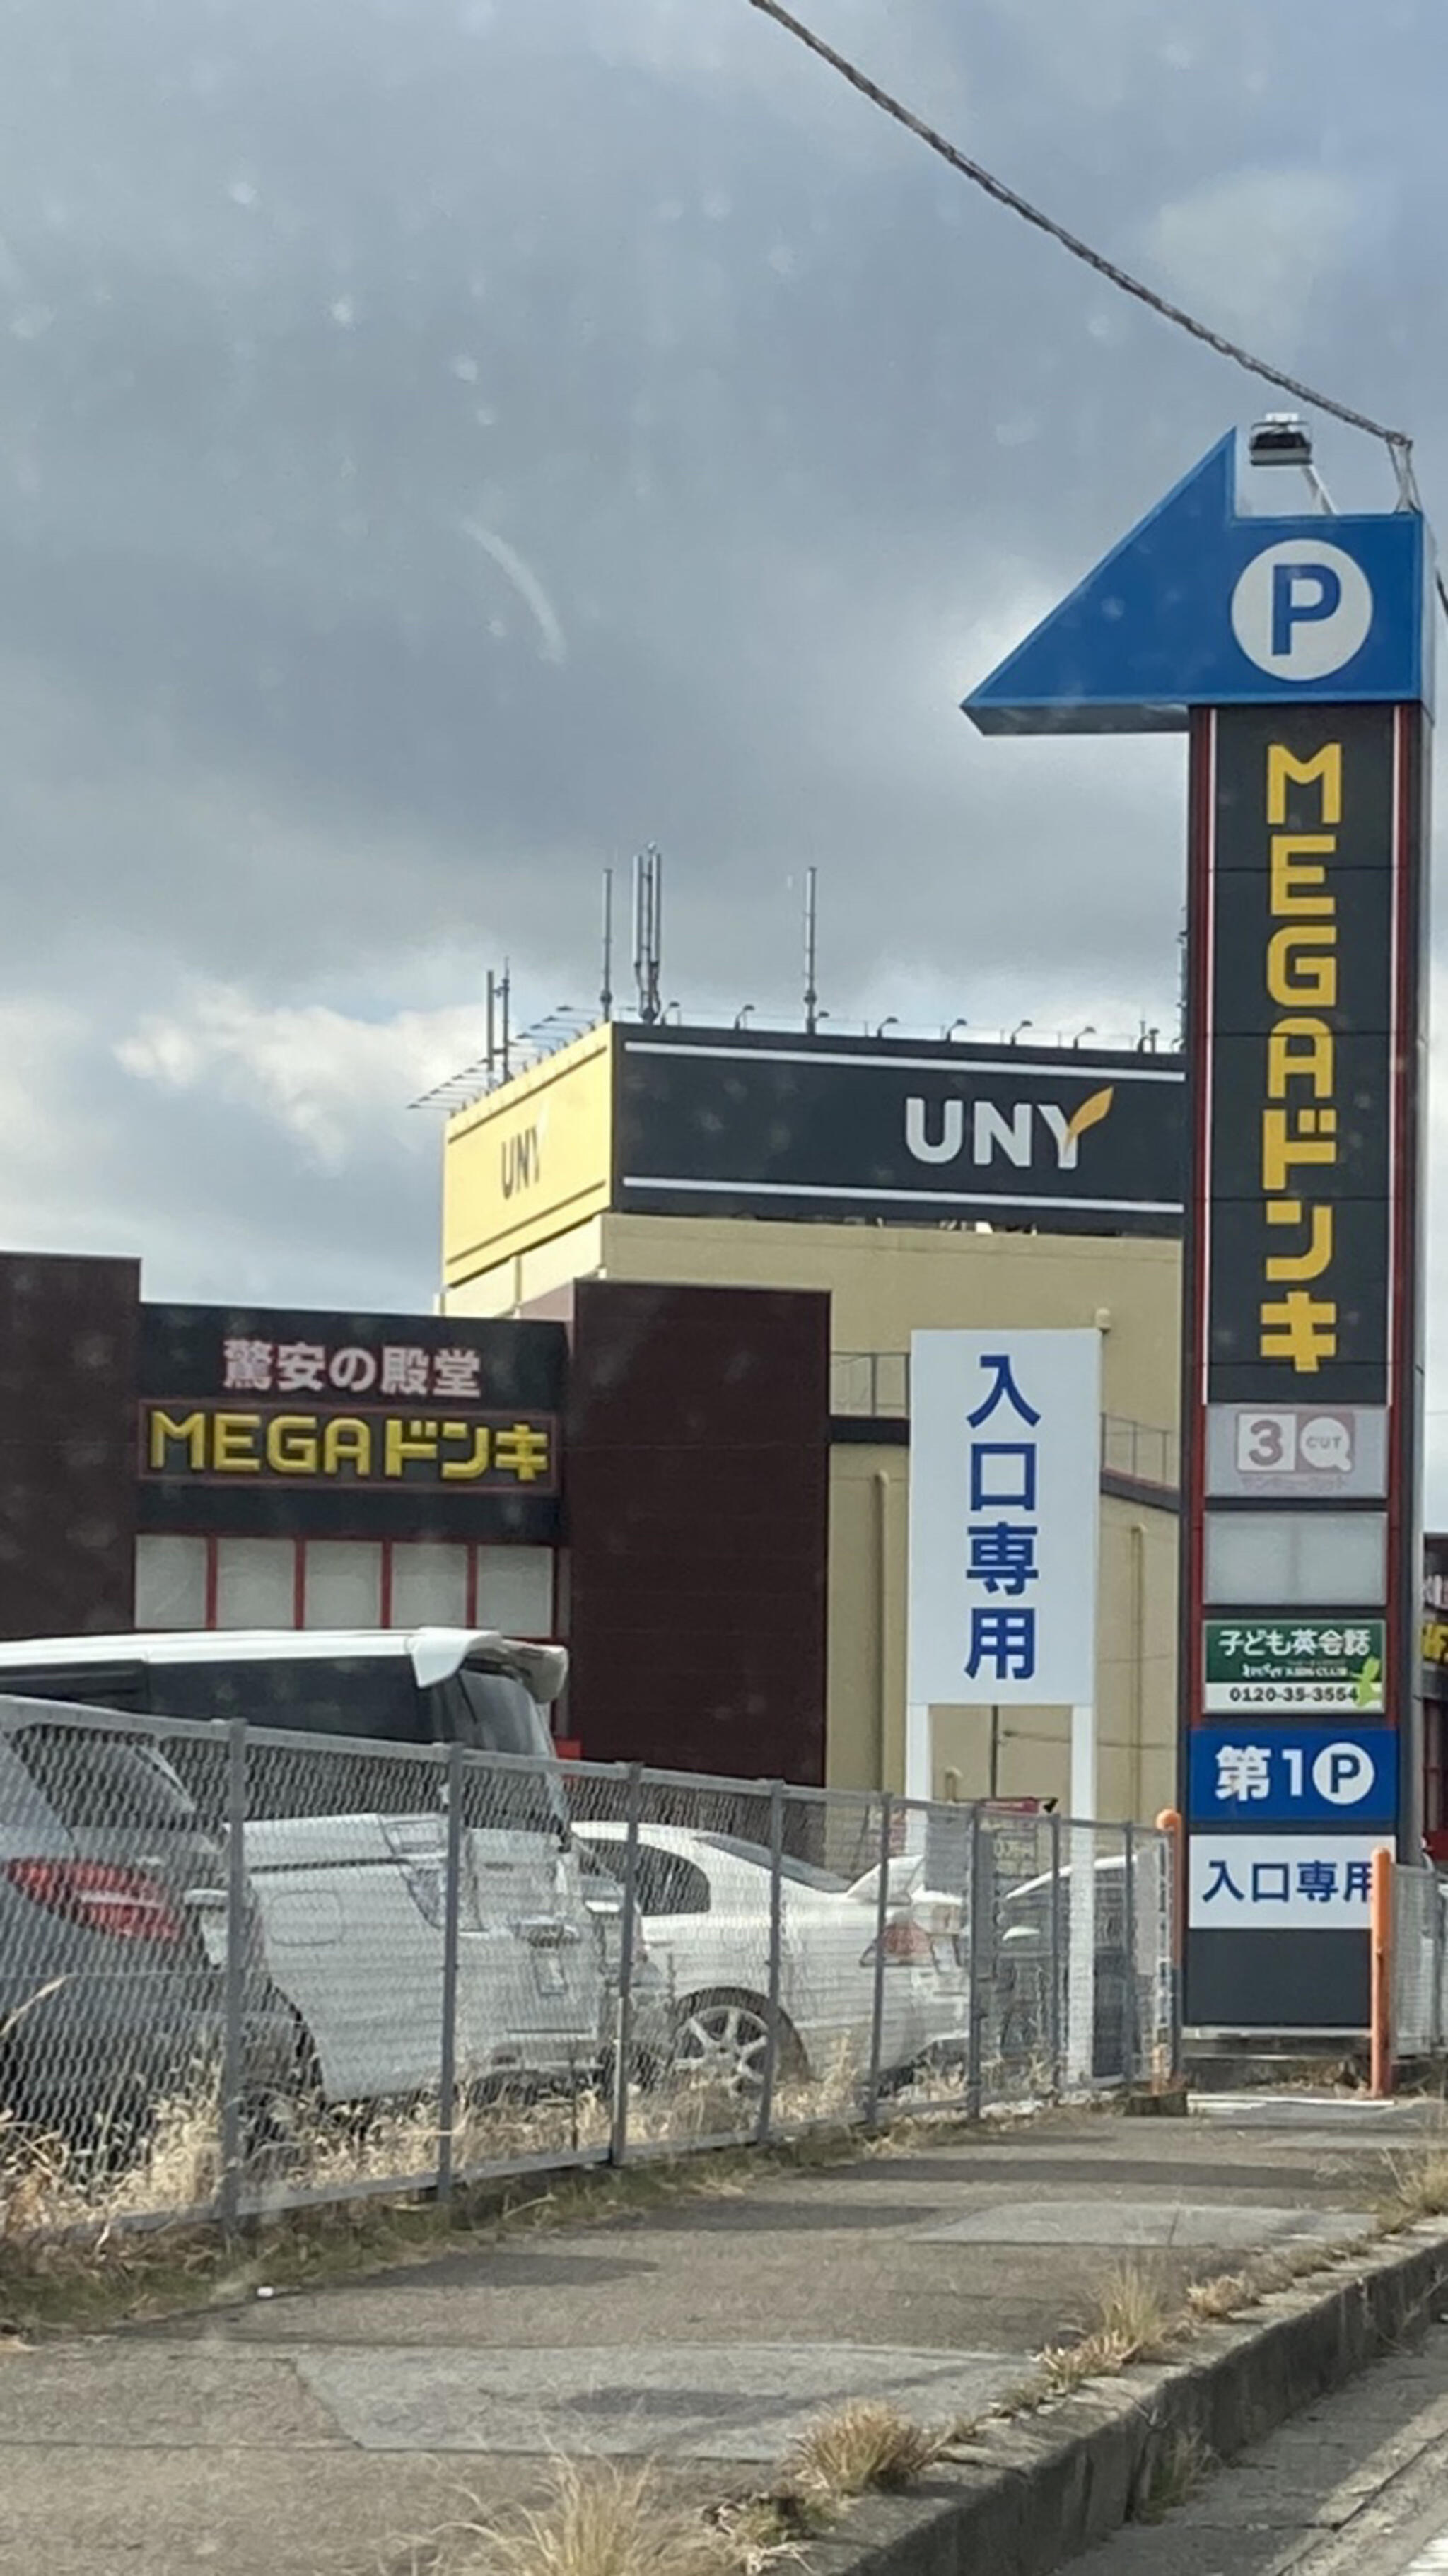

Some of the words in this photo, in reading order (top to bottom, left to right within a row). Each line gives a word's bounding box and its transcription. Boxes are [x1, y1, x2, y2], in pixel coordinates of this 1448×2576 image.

[1272, 564, 1341, 656] P
[1260, 742, 1342, 1372] MEGAドンキ
[501, 1122, 542, 1201] UNY
[906, 1087, 1113, 1168] UNY
[223, 1339, 481, 1398] 驚安の殿堂
[149, 1411, 549, 1481] MEGAドンキ
[1306, 1436, 1341, 1449] CUT
[964, 1355, 1041, 1680] 入口専用
[1218, 1628, 1371, 1655] 子ども英会話
[1230, 1686, 1359, 1702] 0120-35-3554
[1203, 1860, 1372, 1902] 入口専用
